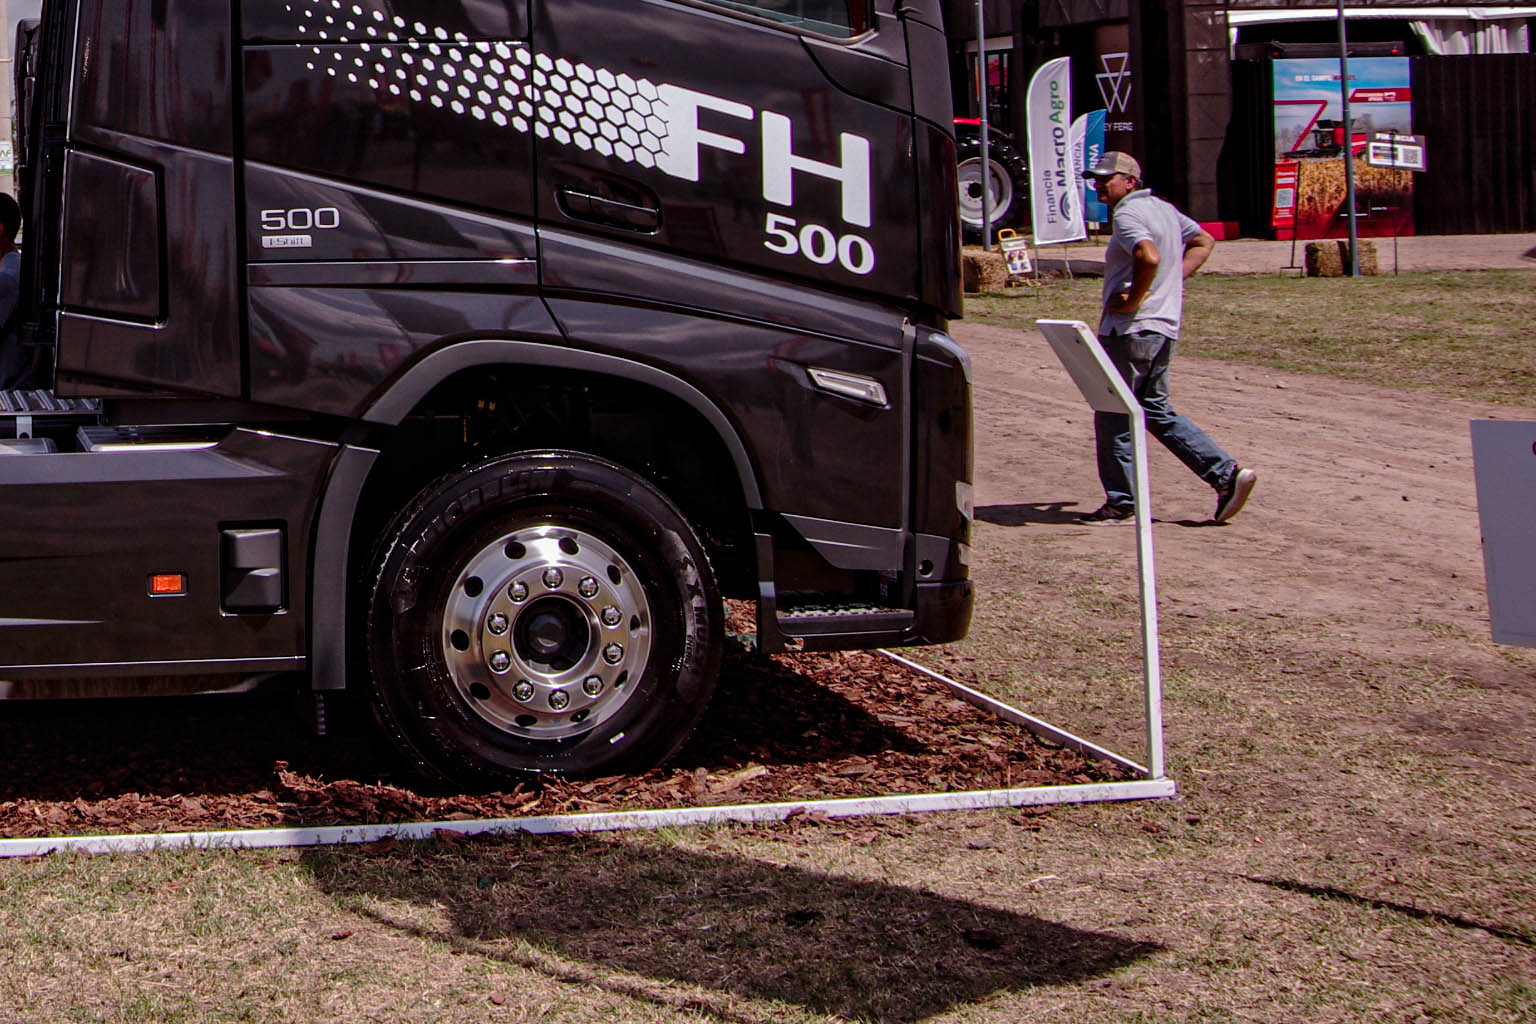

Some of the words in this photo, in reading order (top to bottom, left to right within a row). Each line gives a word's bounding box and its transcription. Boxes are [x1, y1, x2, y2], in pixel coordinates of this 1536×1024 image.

[657, 82, 871, 228] FH
[261, 207, 340, 230] 500
[1042, 170, 1057, 224] Financia
[764, 212, 875, 275] 500
